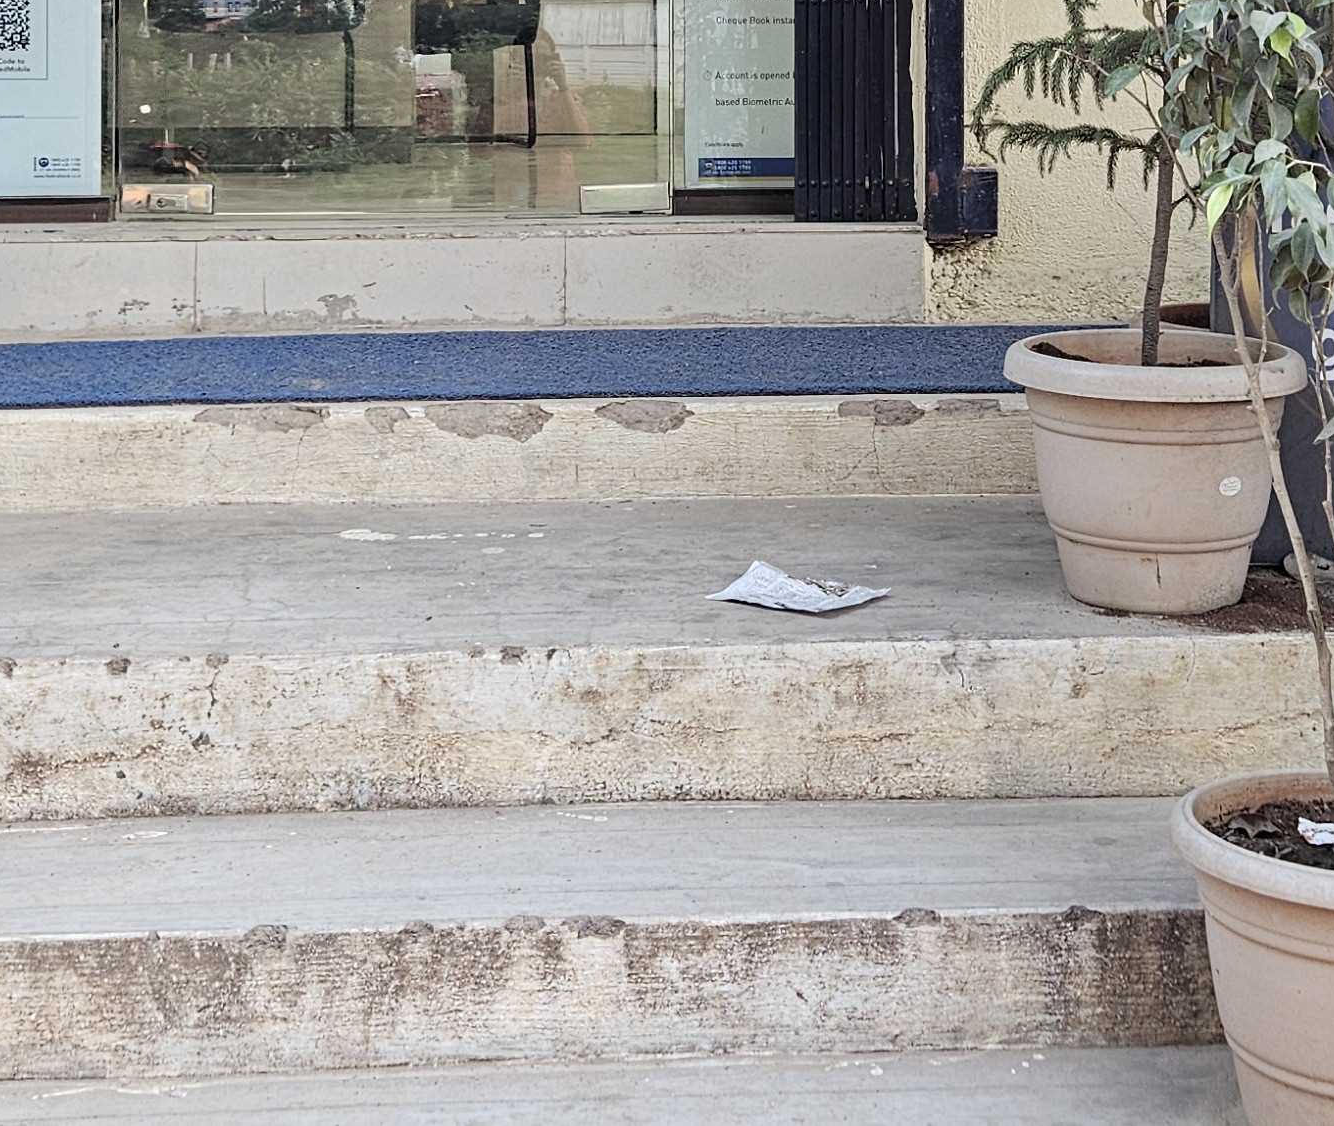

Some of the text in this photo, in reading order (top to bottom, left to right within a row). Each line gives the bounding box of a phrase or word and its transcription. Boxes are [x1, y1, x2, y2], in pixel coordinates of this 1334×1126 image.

[715, 16, 748, 26] Cheque
[749, 16, 770, 24] Book
[715, 71, 749, 80] Account
[760, 71, 790, 81] opened
[715, 97, 740, 106] based
[742, 97, 783, 106] Biometric
